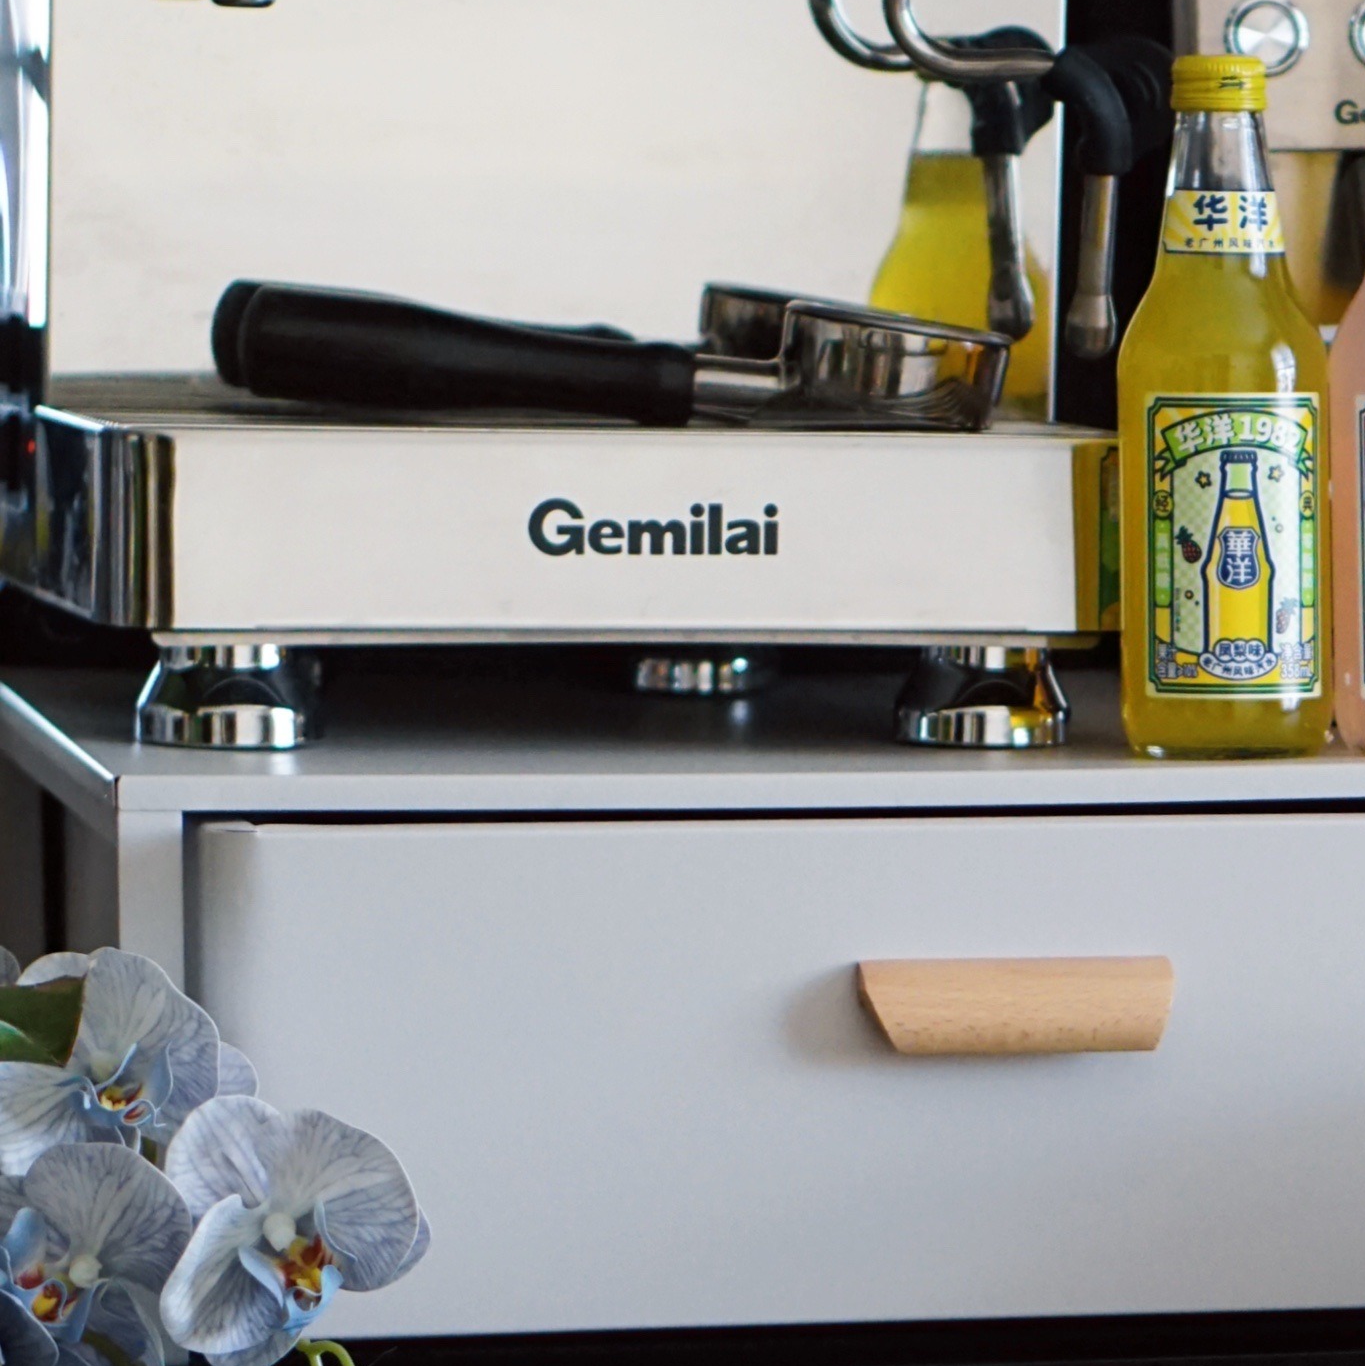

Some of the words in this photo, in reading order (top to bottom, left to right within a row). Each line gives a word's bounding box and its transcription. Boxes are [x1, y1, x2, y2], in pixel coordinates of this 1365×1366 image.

[1193, 194, 1268, 232] 华洋
[528, 498, 778, 556] Gemilai
[1225, 530, 1252, 584] 華洋
